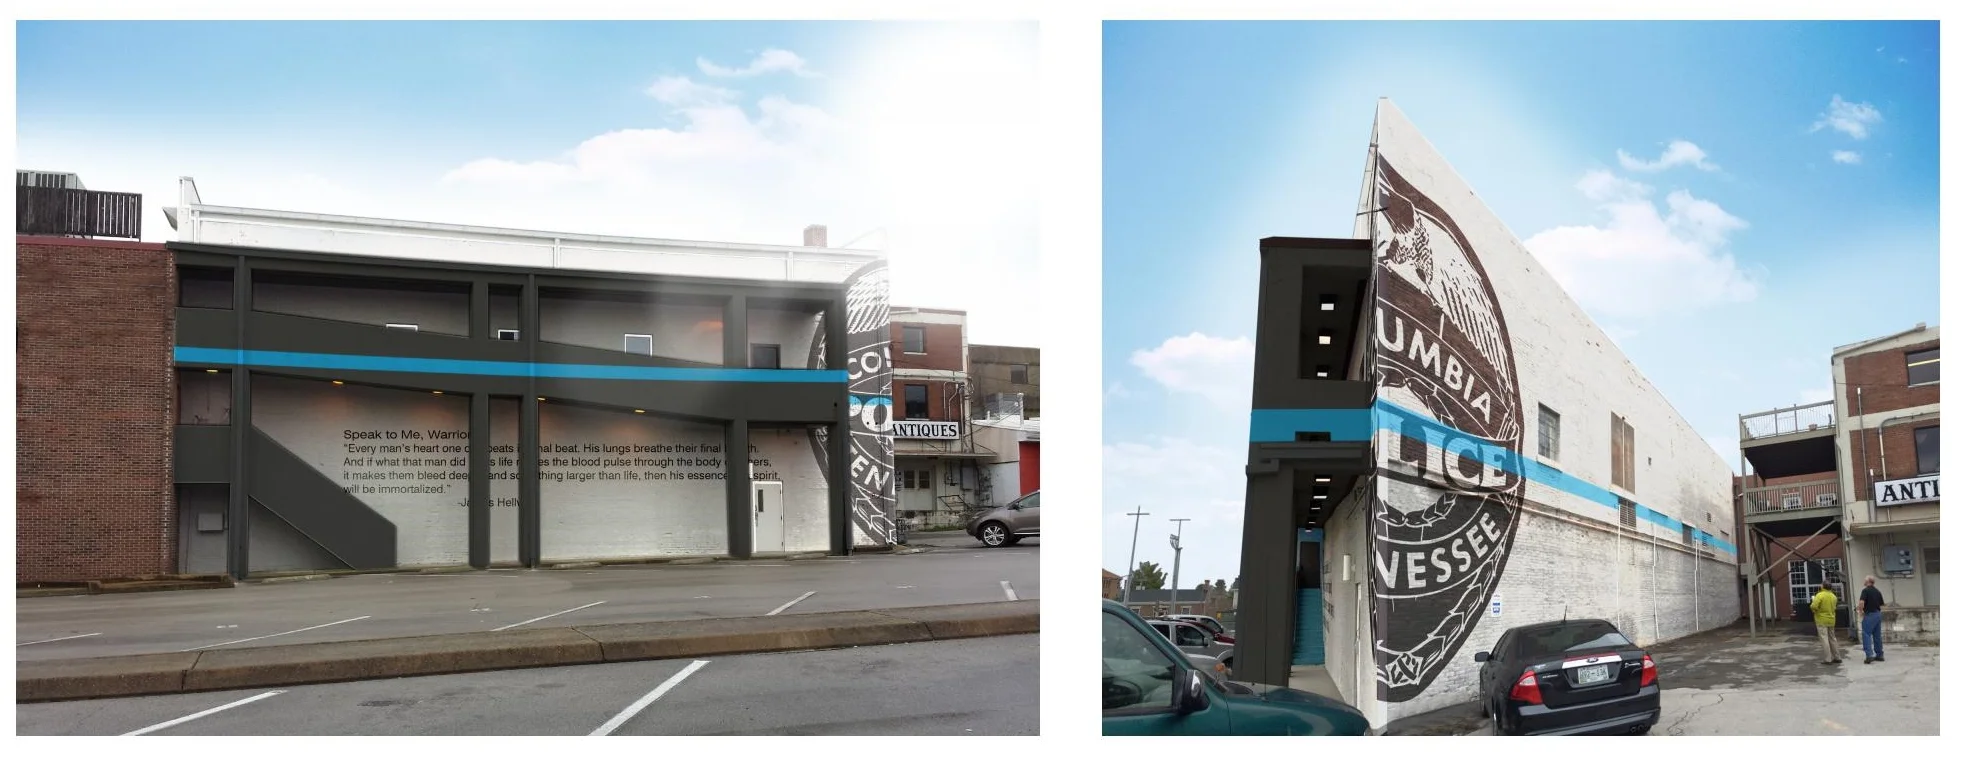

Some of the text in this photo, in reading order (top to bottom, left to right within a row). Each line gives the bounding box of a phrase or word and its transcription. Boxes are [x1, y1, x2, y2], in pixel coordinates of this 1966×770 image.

[343, 429, 382, 441] Speak
[385, 430, 398, 440] to
[401, 429, 423, 441] Me,
[893, 423, 957, 437] ANTIQUES
[379, 443, 411, 453] man’s
[413, 443, 440, 453] heart
[442, 445, 462, 453] one
[555, 443, 580, 453] beat.
[583, 443, 600, 453] His
[602, 443, 631, 455] lungs
[633, 443, 672, 453] breathe
[675, 443, 698, 453] their
[700, 443, 721, 453] final
[343, 457, 364, 467] And
[366, 457, 374, 467] if
[376, 457, 400, 467] what
[402, 457, 422, 467] that
[424, 458, 447, 467] man
[450, 456, 466, 467] did
[498, 457, 513, 467] life
[552, 457, 569, 467] the
[571, 457, 601, 467] blood
[603, 457, 632, 468] pulse
[634, 457, 674, 469] through
[677, 457, 693, 467] the
[695, 457, 721, 469] body
[343, 470, 349, 480] it
[352, 470, 386, 480] makes
[389, 470, 414, 480] them
[417, 470, 446, 480] bleed
[488, 470, 507, 480] and
[566, 470, 596, 482] larger
[599, 470, 621, 480] than
[623, 470, 641, 481] life,
[644, 470, 667, 480] then
[669, 470, 685, 480] his
[687, 472, 728, 480] essence
[342, 484, 359, 494] will
[362, 484, 376, 494] be
[1881, 479, 1940, 503] ANTI
